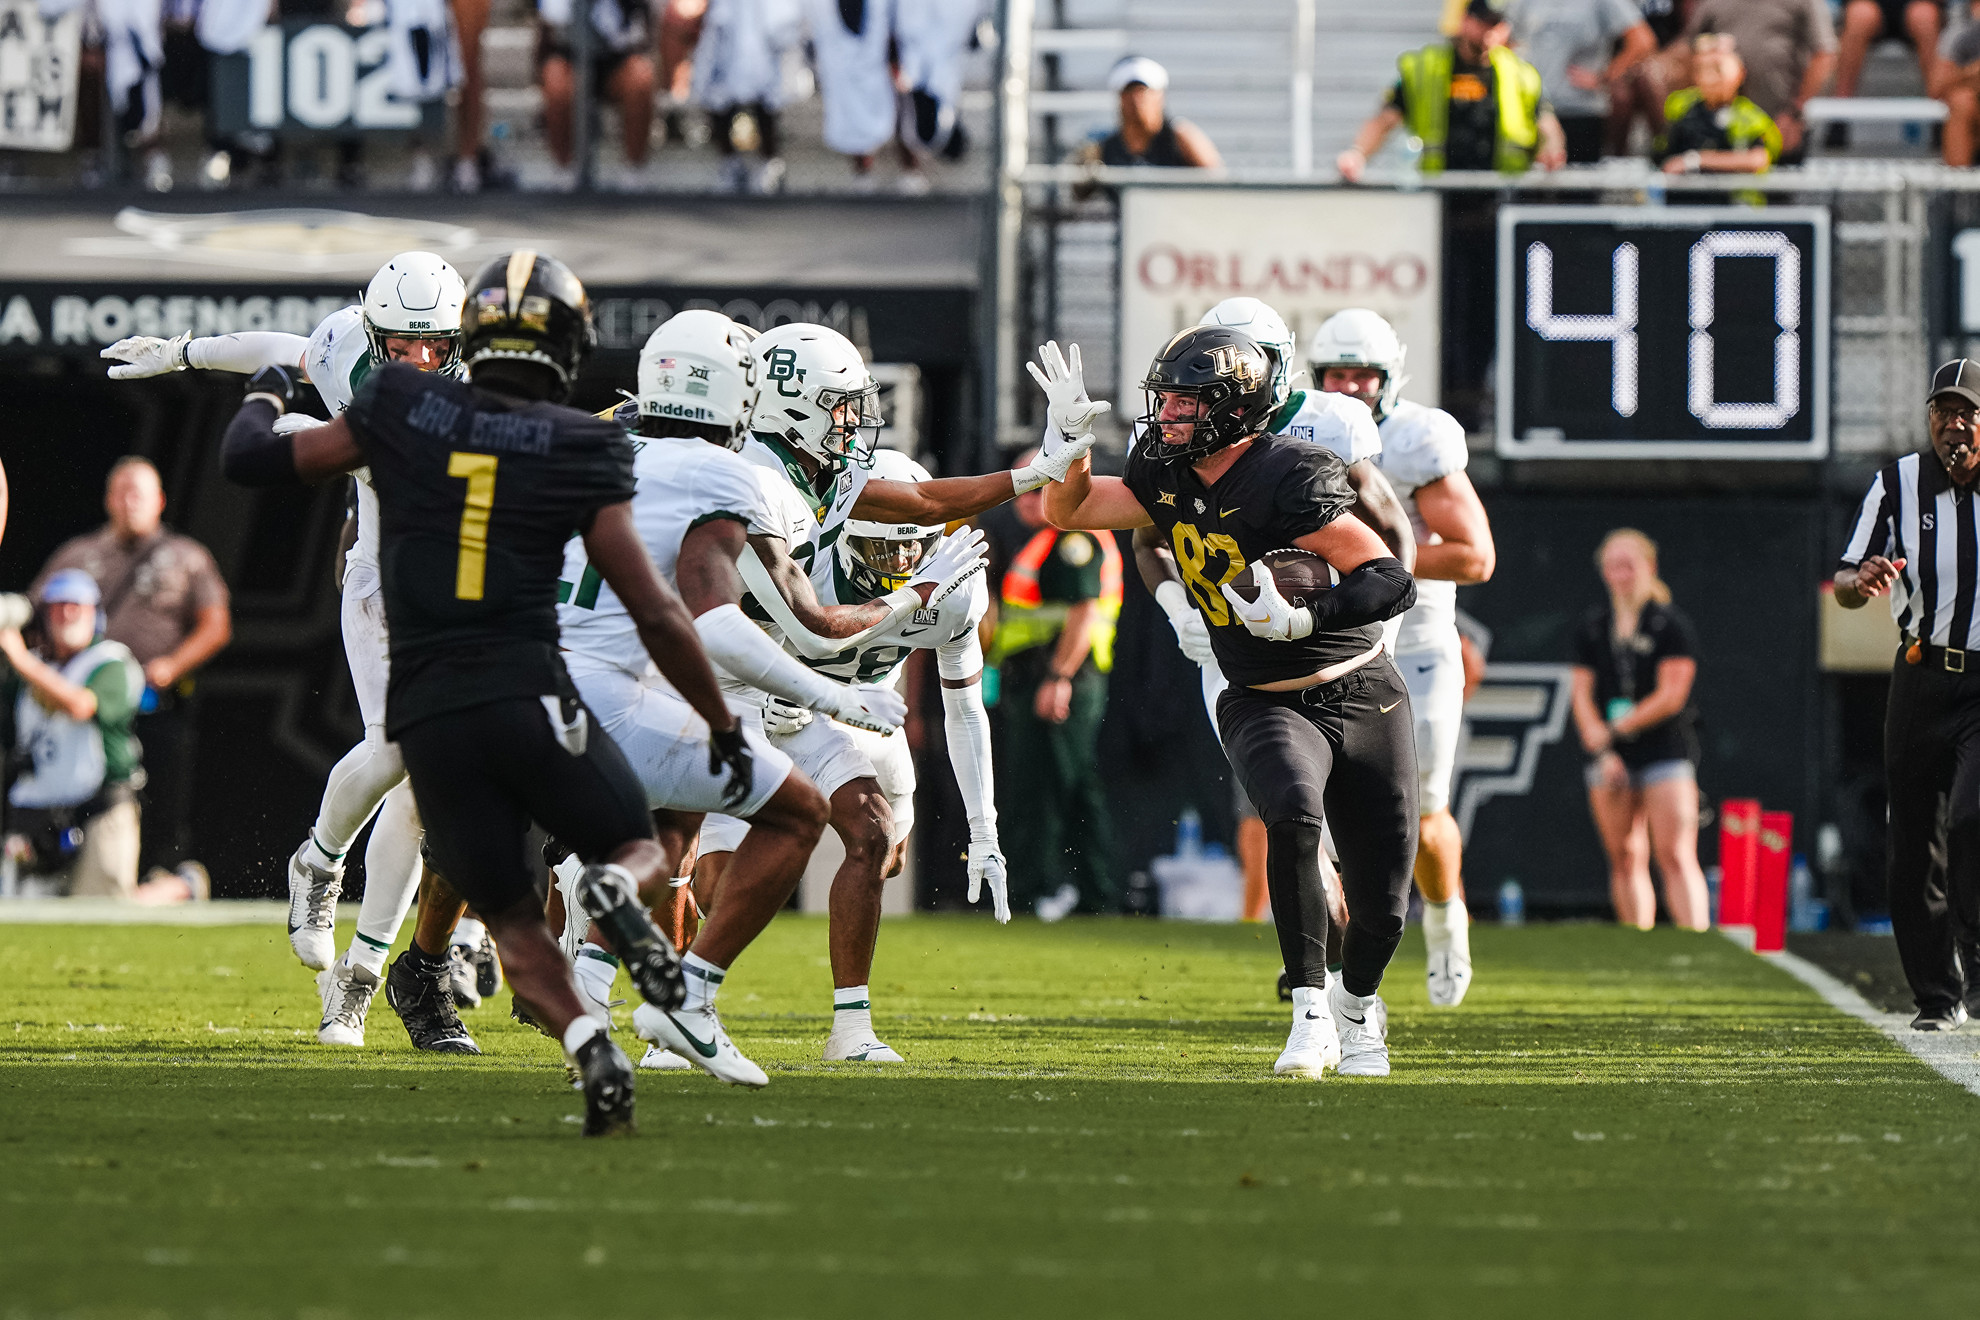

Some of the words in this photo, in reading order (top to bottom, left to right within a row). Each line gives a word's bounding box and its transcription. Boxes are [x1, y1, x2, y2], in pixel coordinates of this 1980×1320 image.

[247, 23, 424, 130] 102
[1137, 241, 1429, 298] ORLANDO
[409, 321, 430, 329] BEARS
[1526, 230, 1801, 430] 40
[1203, 344, 1262, 393] UCF
[649, 401, 705, 420] Riddell
[1292, 427, 1314, 442] ONE
[447, 451, 499, 601] 1
[897, 526, 918, 535] BEARS
[1922, 513, 1935, 531] S
[1171, 520, 1246, 627] 82
[915, 608, 938, 621] ONE
